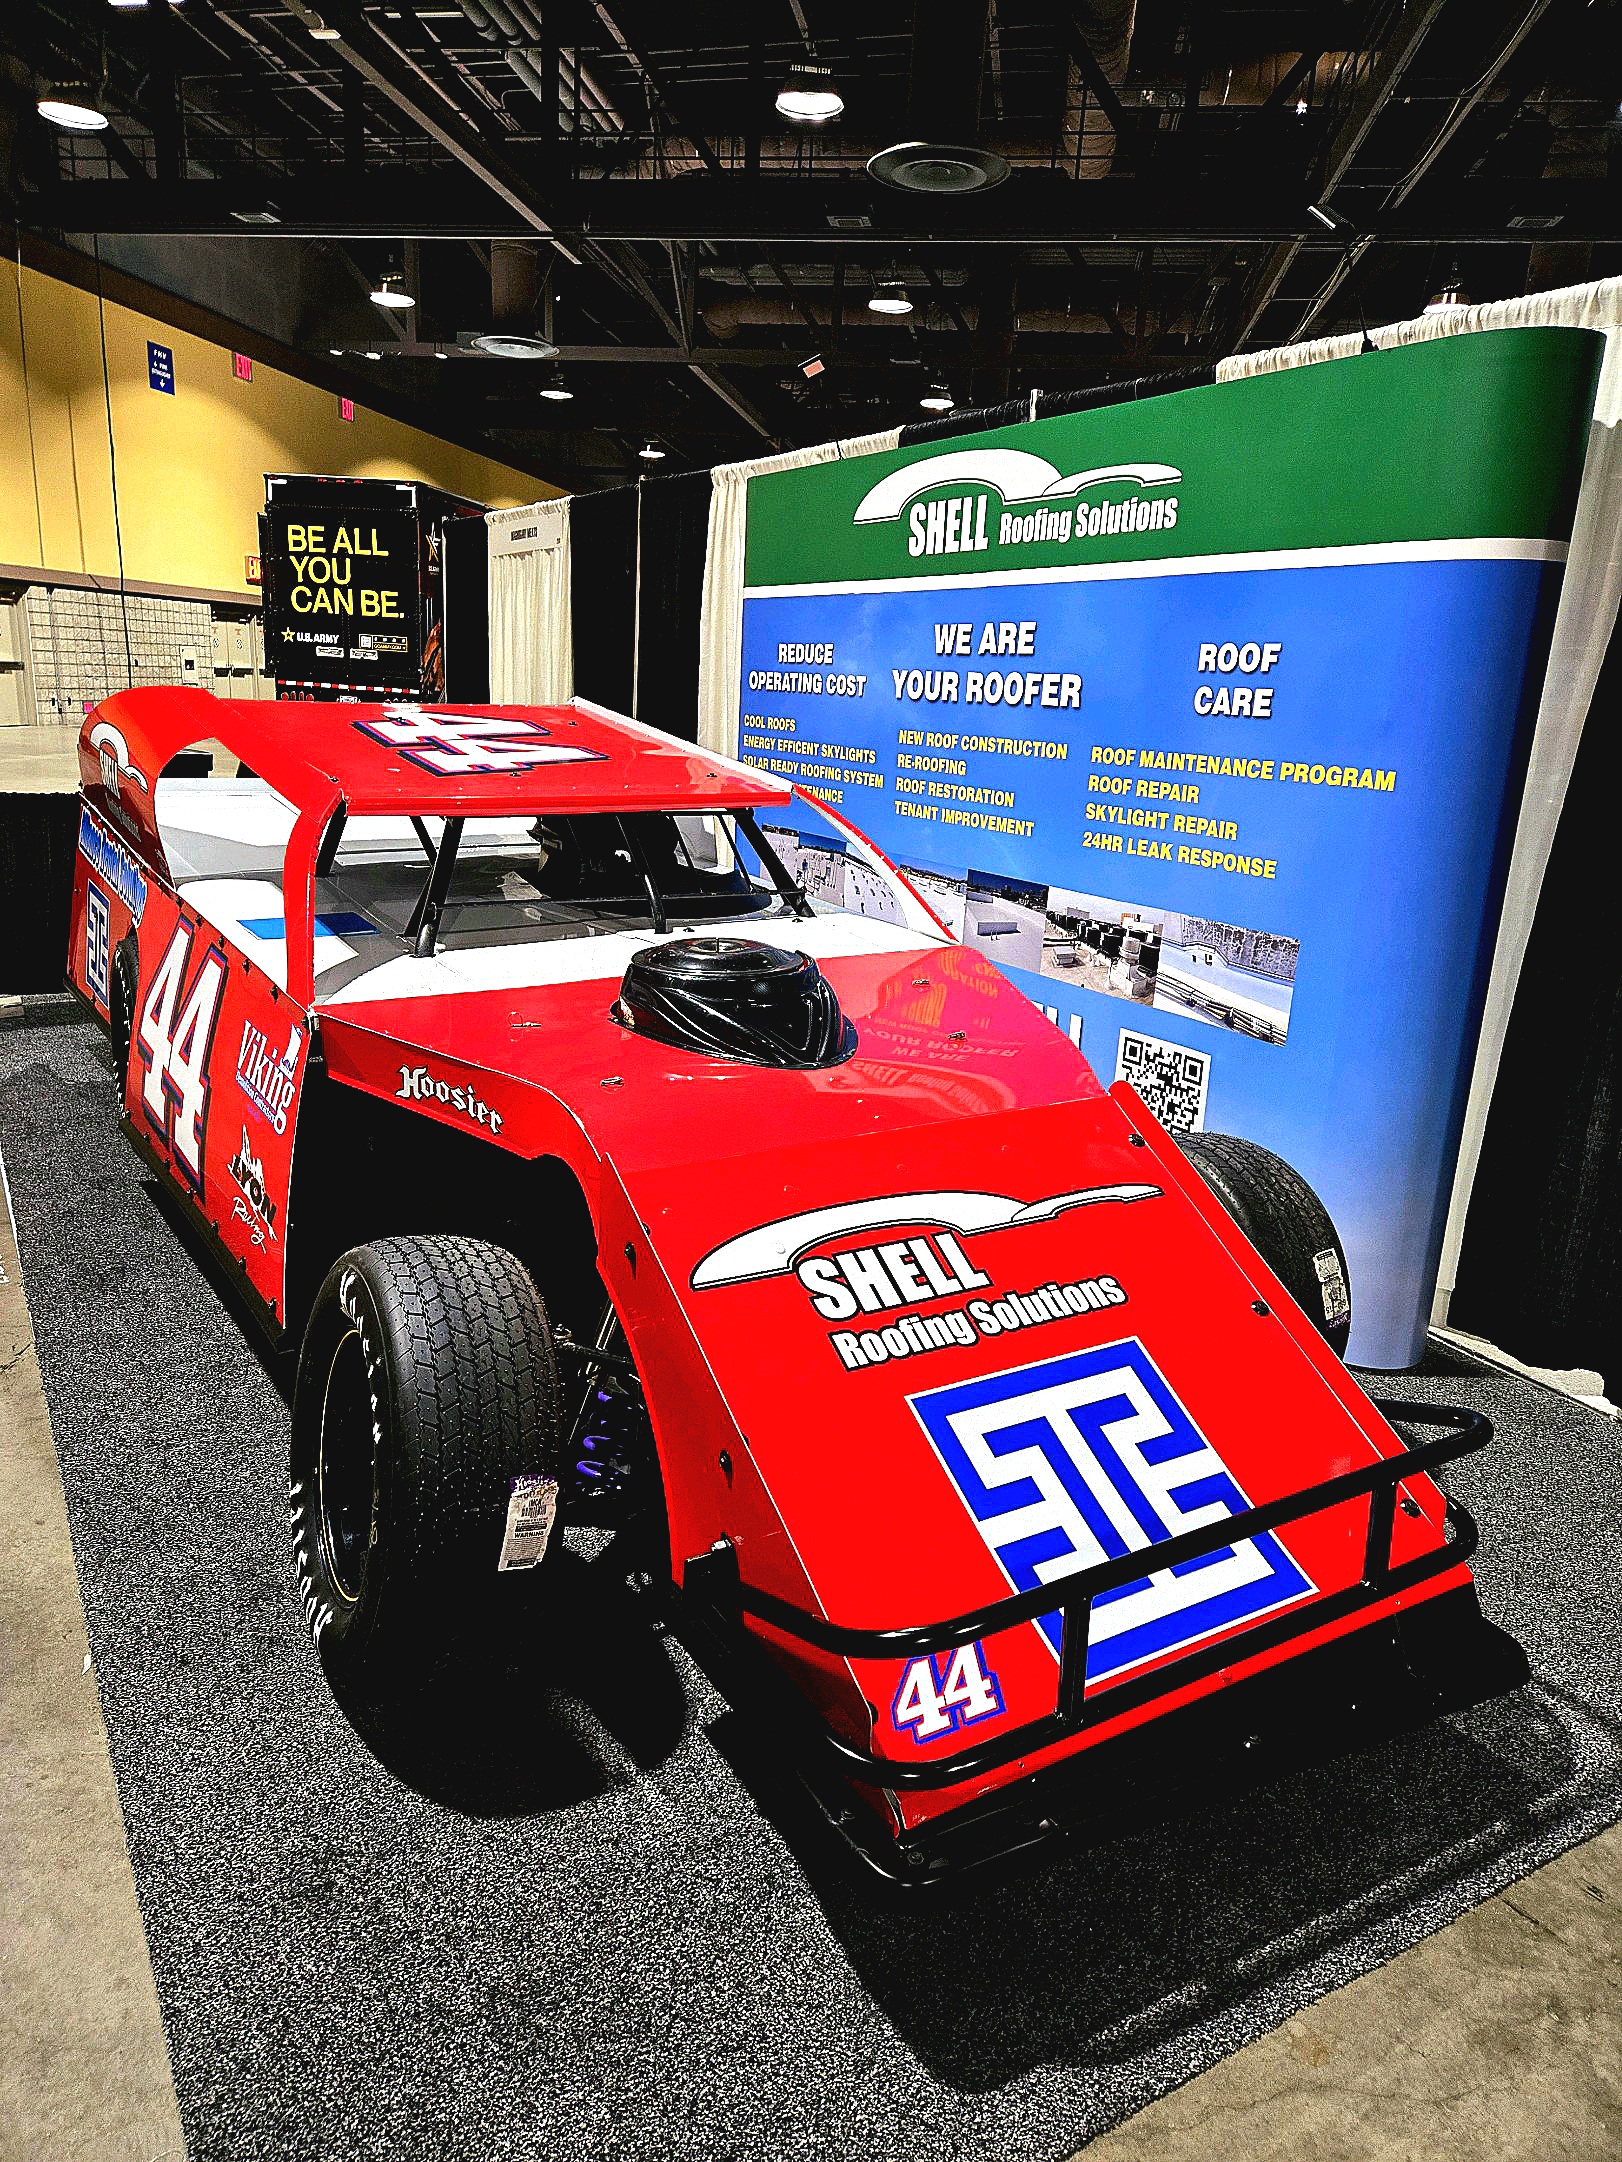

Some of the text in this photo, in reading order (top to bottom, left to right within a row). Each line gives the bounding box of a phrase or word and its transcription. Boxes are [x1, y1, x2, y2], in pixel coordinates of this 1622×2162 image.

[235, 353, 252, 380] EXIT
[341, 397, 354, 421] EXIT
[287, 524, 389, 557] BE ALL
[908, 495, 1179, 557] SHELL Roofing Solutions
[289, 555, 351, 585] YOU
[290, 585, 405, 619] CAN BE.
[313, 633, 339, 645] ARMY
[777, 643, 834, 664] REDUCE
[934, 621, 1037, 655] WE ARE
[1197, 642, 1282, 673] ROOF
[748, 671, 867, 697] OPERATING COST
[891, 669, 1083, 709] YOUR ROOFER
[1193, 685, 1274, 718] CARE
[743, 714, 797, 733] COOL ROOFS
[352, 710, 611, 777] 44
[743, 734, 877, 765] ENERGY EFFICENT SKYLIGHTS
[898, 729, 1069, 761] NEW ROOF CONSTRUCTION
[742, 754, 885, 789] SOLAR READY ROOFING SYSTEM
[896, 753, 968, 777] RE-ROOFING
[1091, 746, 1398, 793] ROOF MAINTENANCE PROGRAM
[895, 776, 1016, 809] ROOF RESTORATION
[1087, 774, 1201, 805] ROOF REPAIR
[894, 800, 1036, 838] TENANT IMPROVEMENT
[1085, 802, 1239, 842] SKYLIGHT REPAIR
[1082, 831, 1279, 880] 24HR LEAK RESPONSE
[138, 914, 227, 1200] 44
[237, 1018, 297, 1137] Viking
[394, 1064, 504, 1135] Hoosier
[797, 1230, 994, 1322] SHELL
[827, 1274, 1129, 1373] Roofing Solutions
[892, 1640, 1007, 1746] 44
